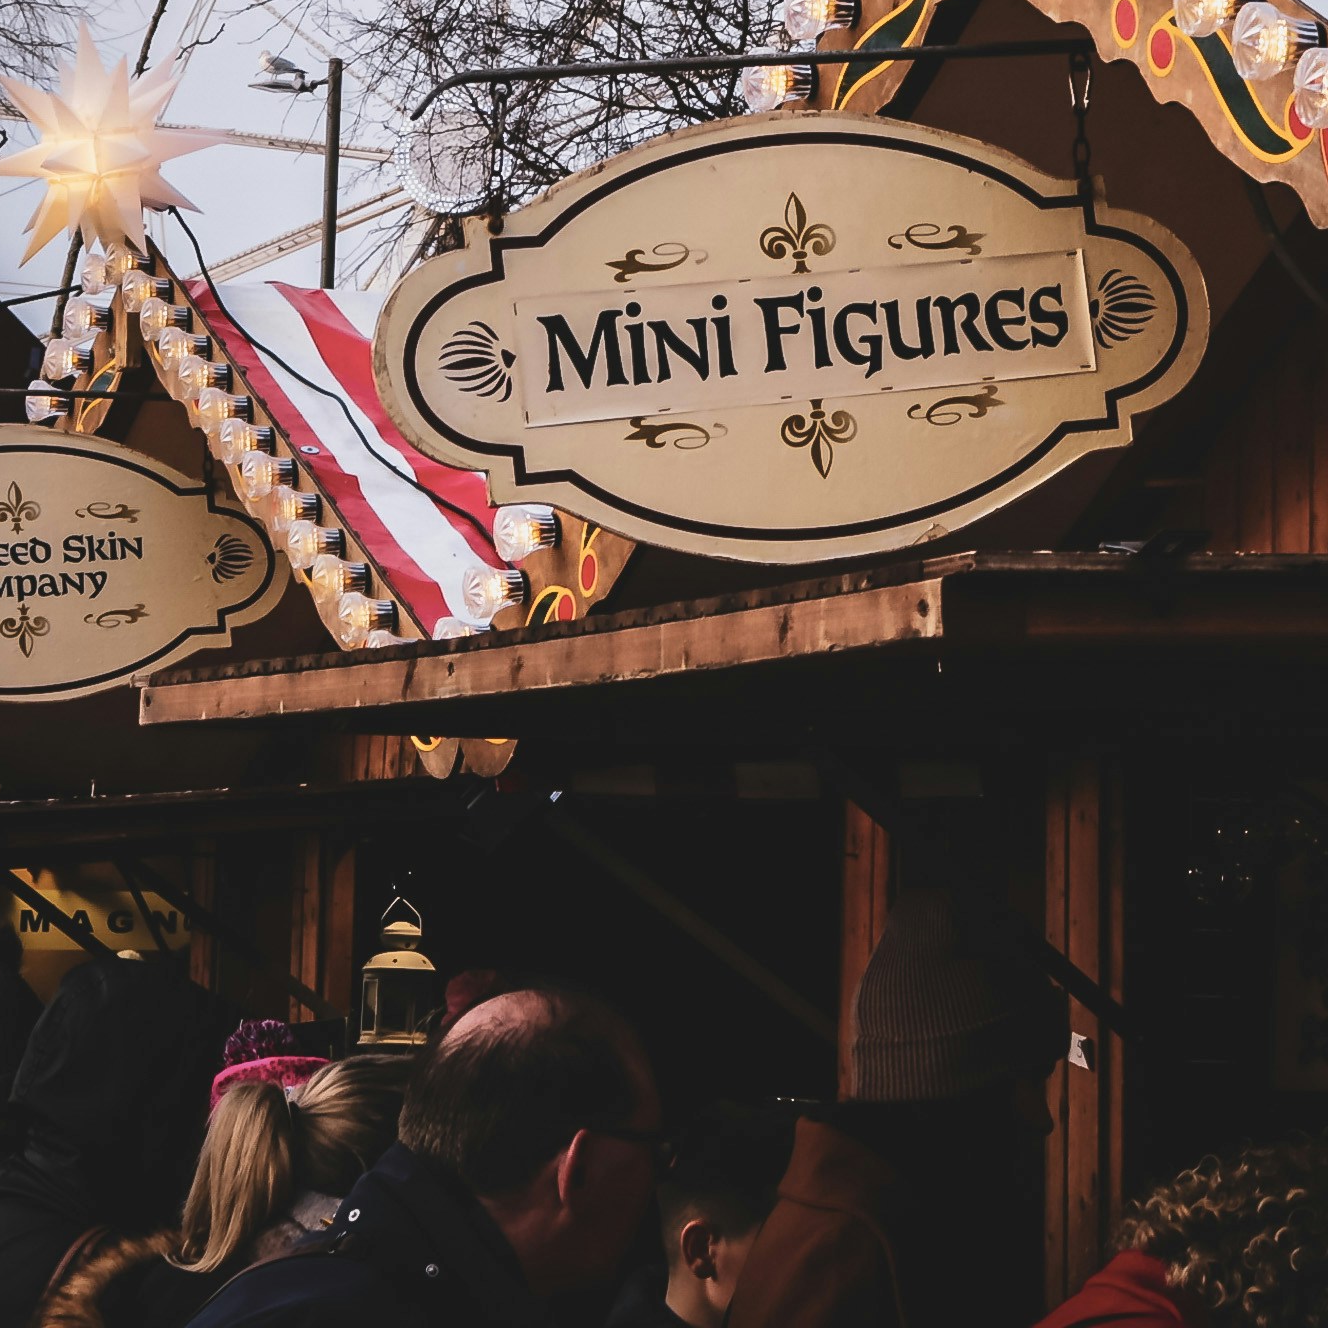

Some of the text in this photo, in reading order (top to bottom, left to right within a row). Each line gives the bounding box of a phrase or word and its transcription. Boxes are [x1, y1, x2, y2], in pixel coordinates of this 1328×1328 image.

[537, 282, 1070, 393] Mini Figures
[62, 531, 145, 565] Skin
